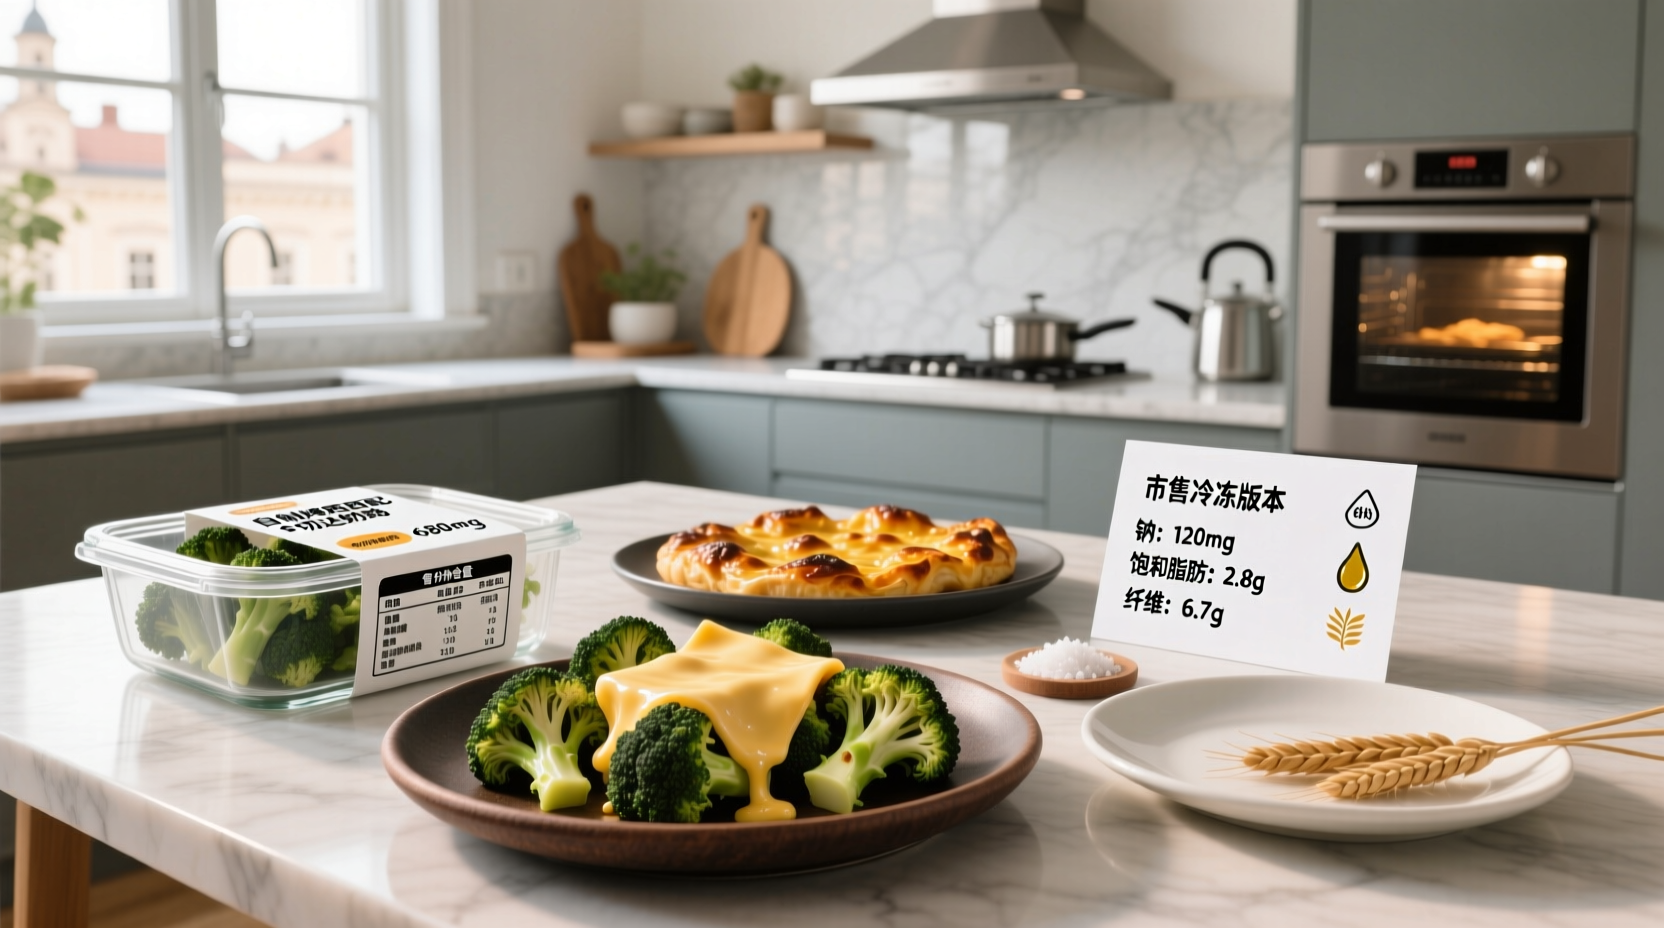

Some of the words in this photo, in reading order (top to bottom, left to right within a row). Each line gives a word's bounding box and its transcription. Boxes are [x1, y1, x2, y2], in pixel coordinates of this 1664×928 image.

[1145, 473, 1287, 514] 市售冷冻版本
[412, 518, 487, 537] 680mg
[1174, 525, 1236, 556] 120mg
[1222, 566, 1266, 596] 2.8g
[1181, 598, 1225, 629] 6.7g
